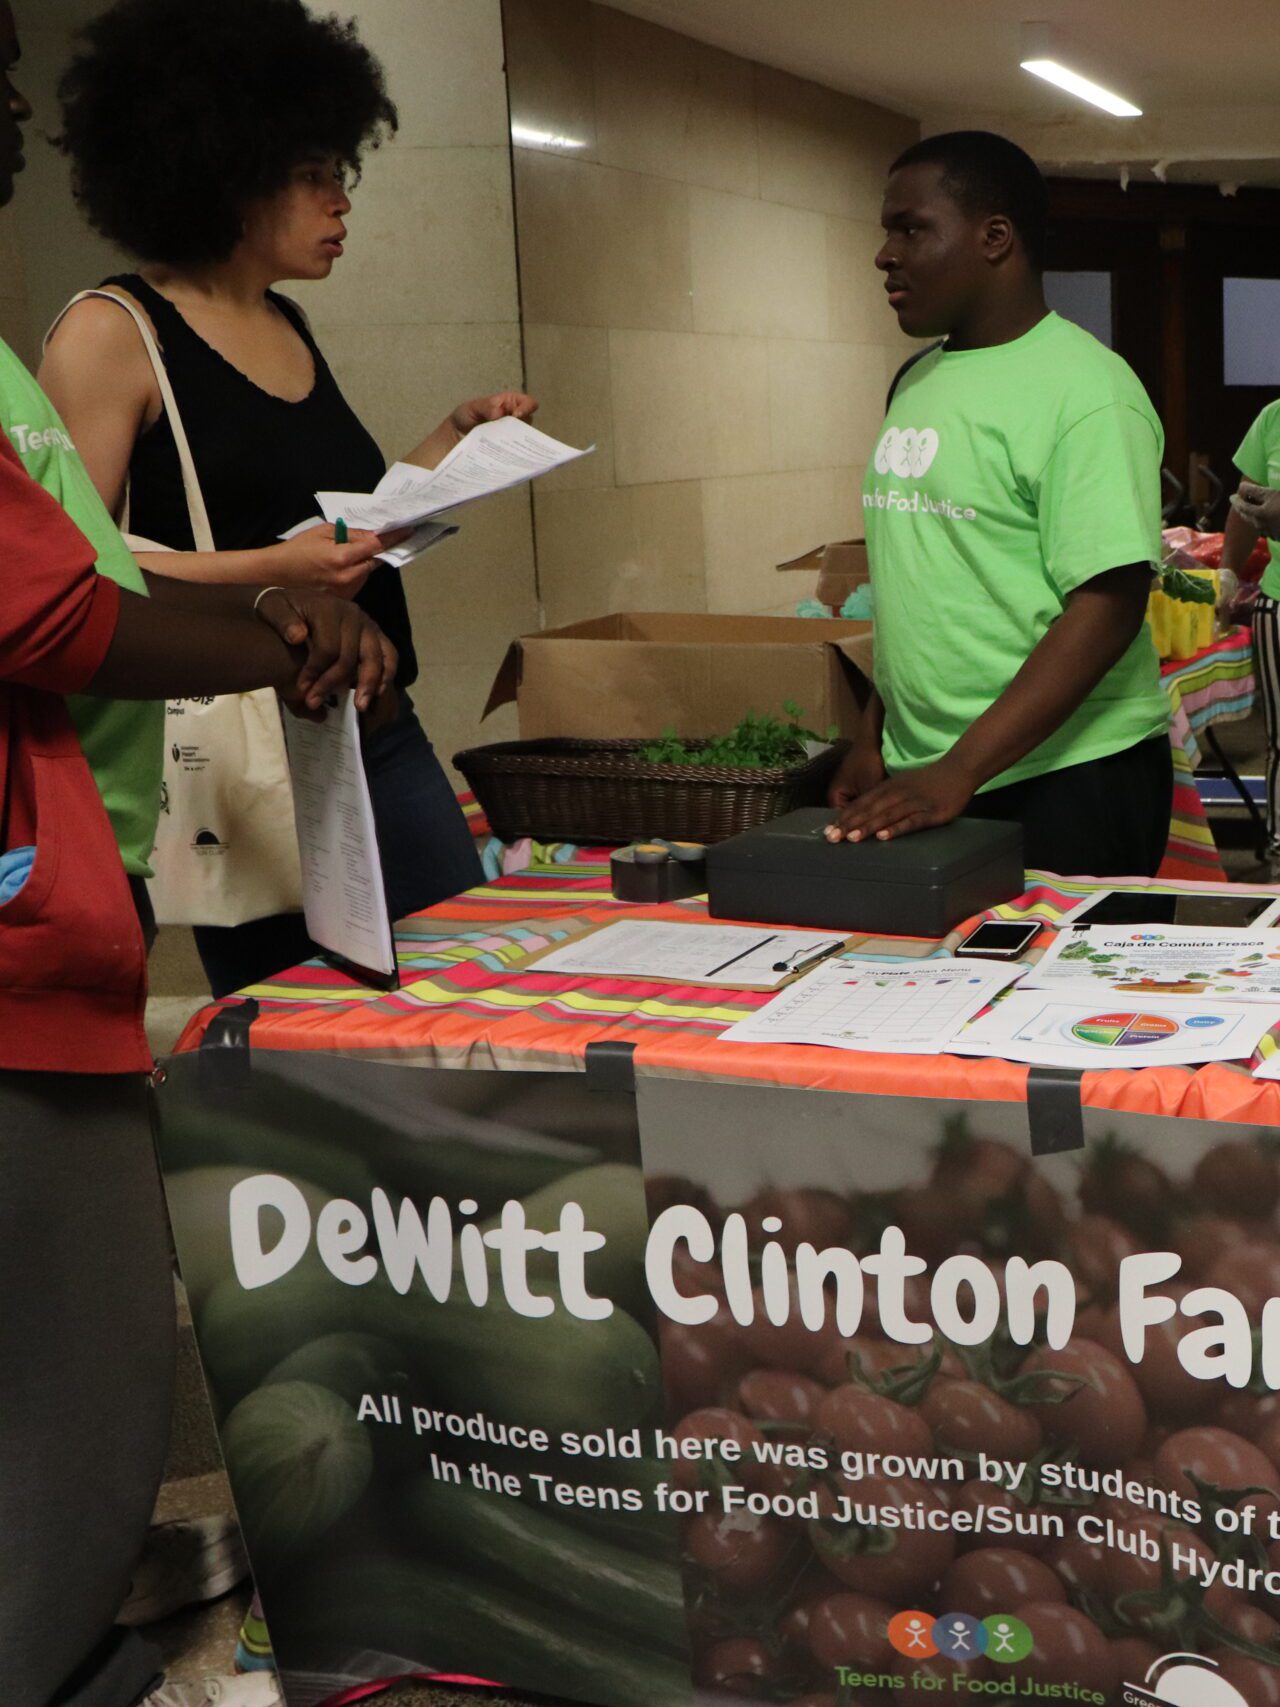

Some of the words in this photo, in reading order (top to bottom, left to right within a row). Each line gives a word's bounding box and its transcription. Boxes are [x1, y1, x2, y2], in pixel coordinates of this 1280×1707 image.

[1103, 940, 1133, 949] Caja
[229, 1174, 613, 1320] DeWitt
[645, 1204, 1077, 1351] Clinton
[357, 1394, 402, 1424] All
[412, 1402, 549, 1452] produce
[561, 1427, 642, 1460] sold
[654, 1430, 741, 1463] here
[752, 1441, 829, 1469] was
[840, 1449, 965, 1480] grown
[979, 1452, 1028, 1490] by
[1039, 1461, 1203, 1525] students
[1213, 1503, 1256, 1536] of
[430, 1453, 462, 1484] In
[468, 1461, 522, 1497] the
[528, 1474, 643, 1511] Teens
[655, 1482, 709, 1514] for
[720, 1486, 819, 1520] Food
[831, 1496, 1065, 1538] Justice/Sun
[1076, 1514, 1161, 1562] Club
[833, 1666, 906, 1690] Teens
[911, 1672, 946, 1692] for
[951, 1675, 1016, 1697] Food
[1020, 1678, 1105, 1706] Justice
